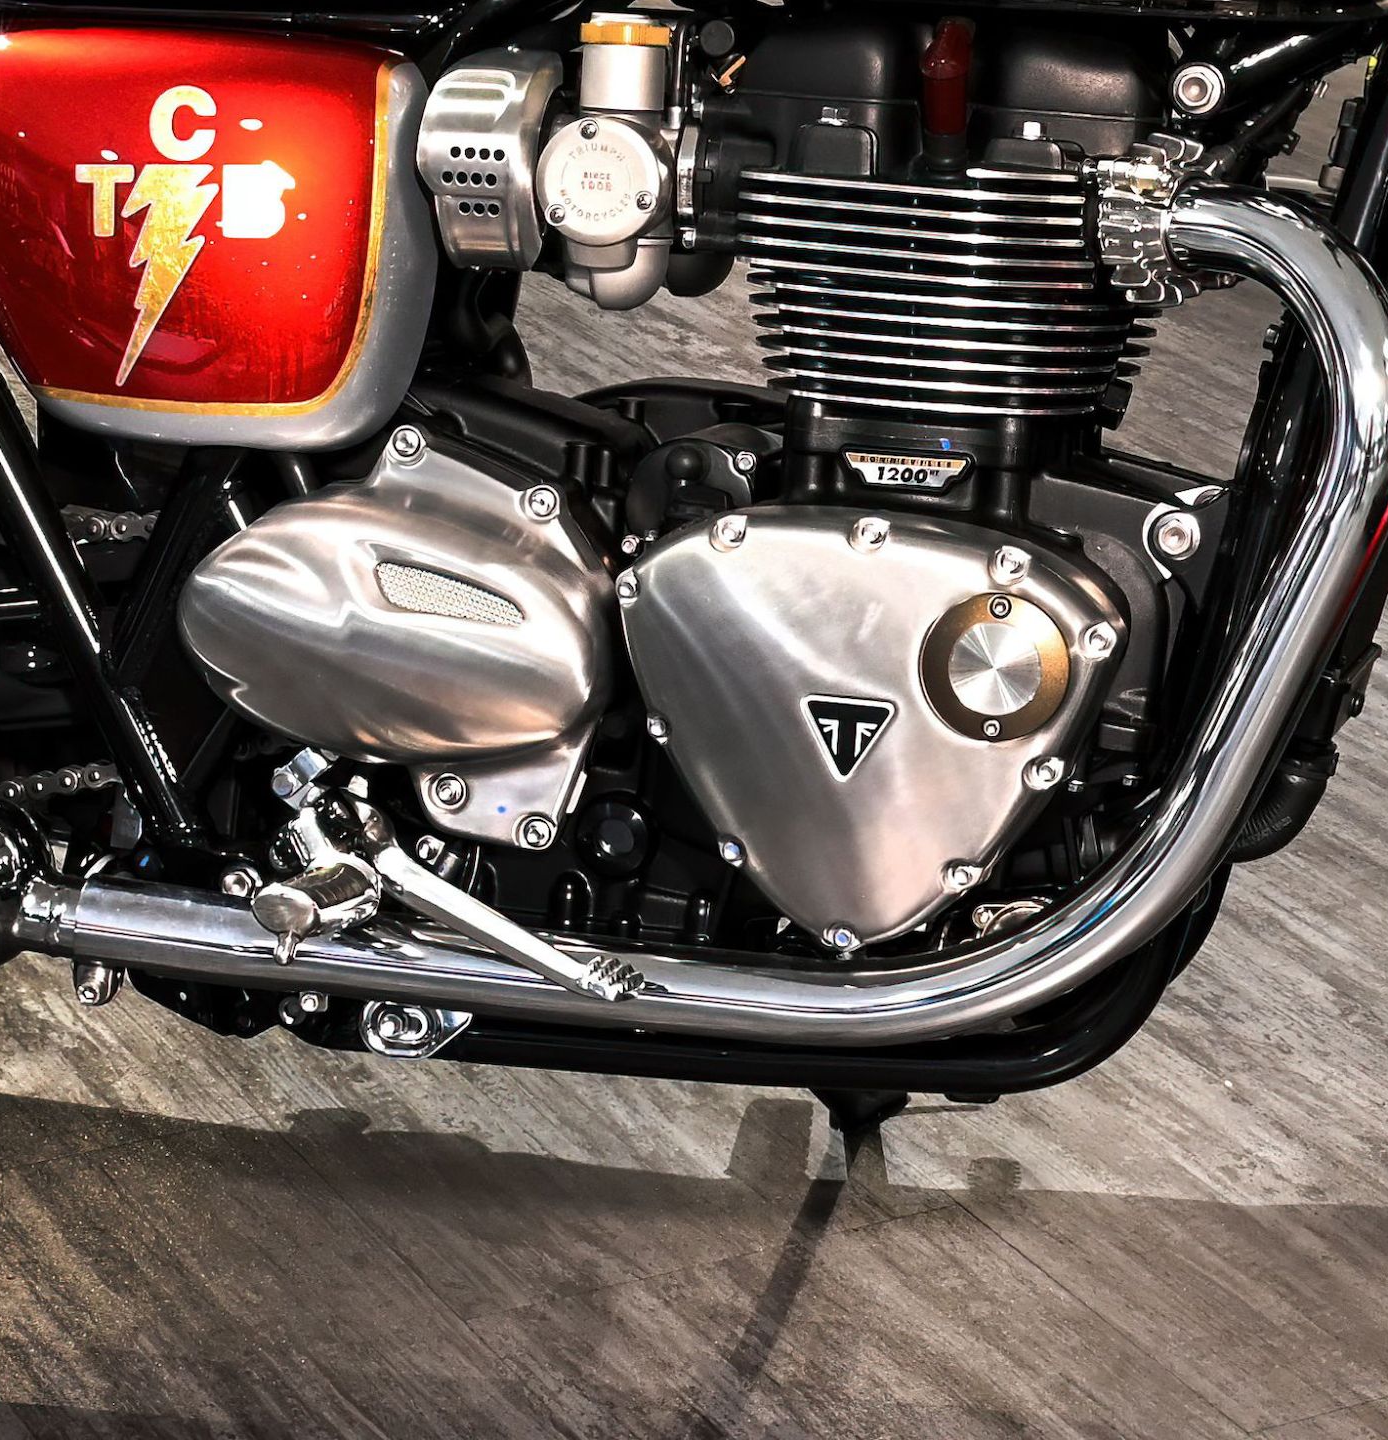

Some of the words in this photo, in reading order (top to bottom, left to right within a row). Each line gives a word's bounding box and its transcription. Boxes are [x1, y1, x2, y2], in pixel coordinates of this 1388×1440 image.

[149, 84, 218, 162] C
[568, 142, 627, 163] TRIUMPH
[877, 466, 928, 484] 1200
